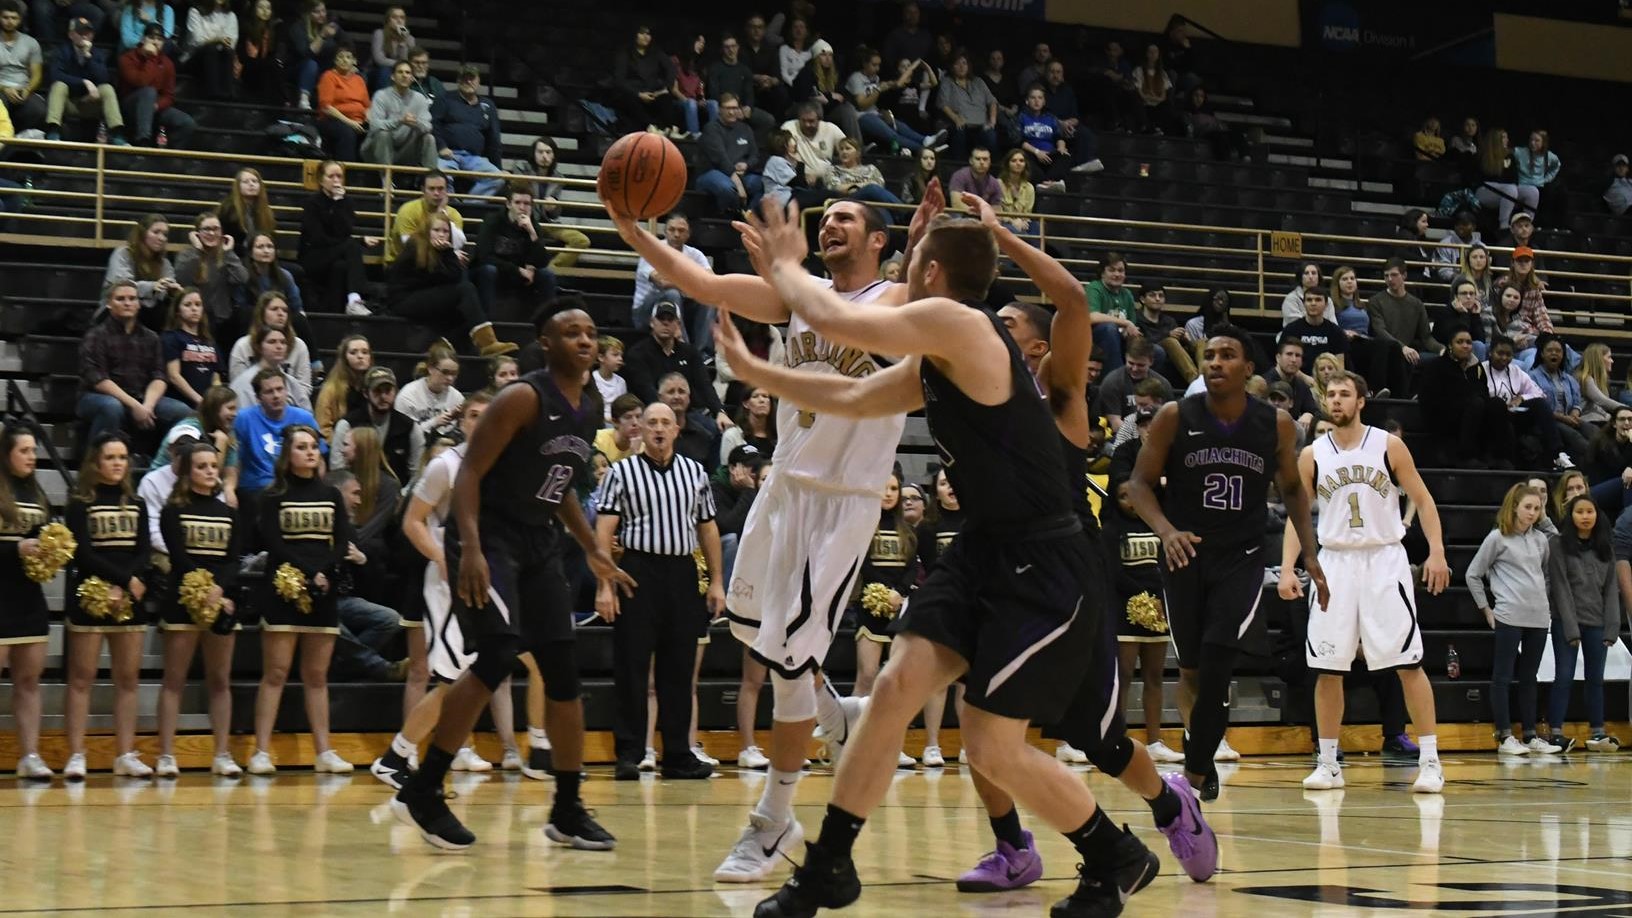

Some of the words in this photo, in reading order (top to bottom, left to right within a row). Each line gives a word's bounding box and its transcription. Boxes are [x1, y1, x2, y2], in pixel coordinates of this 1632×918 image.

[1322, 24, 1360, 43] NCAA
[1363, 29, 1407, 48] Division
[1273, 236, 1300, 253] HOME
[783, 331, 876, 378] ARDING
[1184, 447, 1264, 474] OUACHITA
[535, 464, 573, 504] 12
[1203, 473, 1243, 510] 21
[1347, 492, 1364, 528] 1
[1124, 541, 1157, 557] BISO
